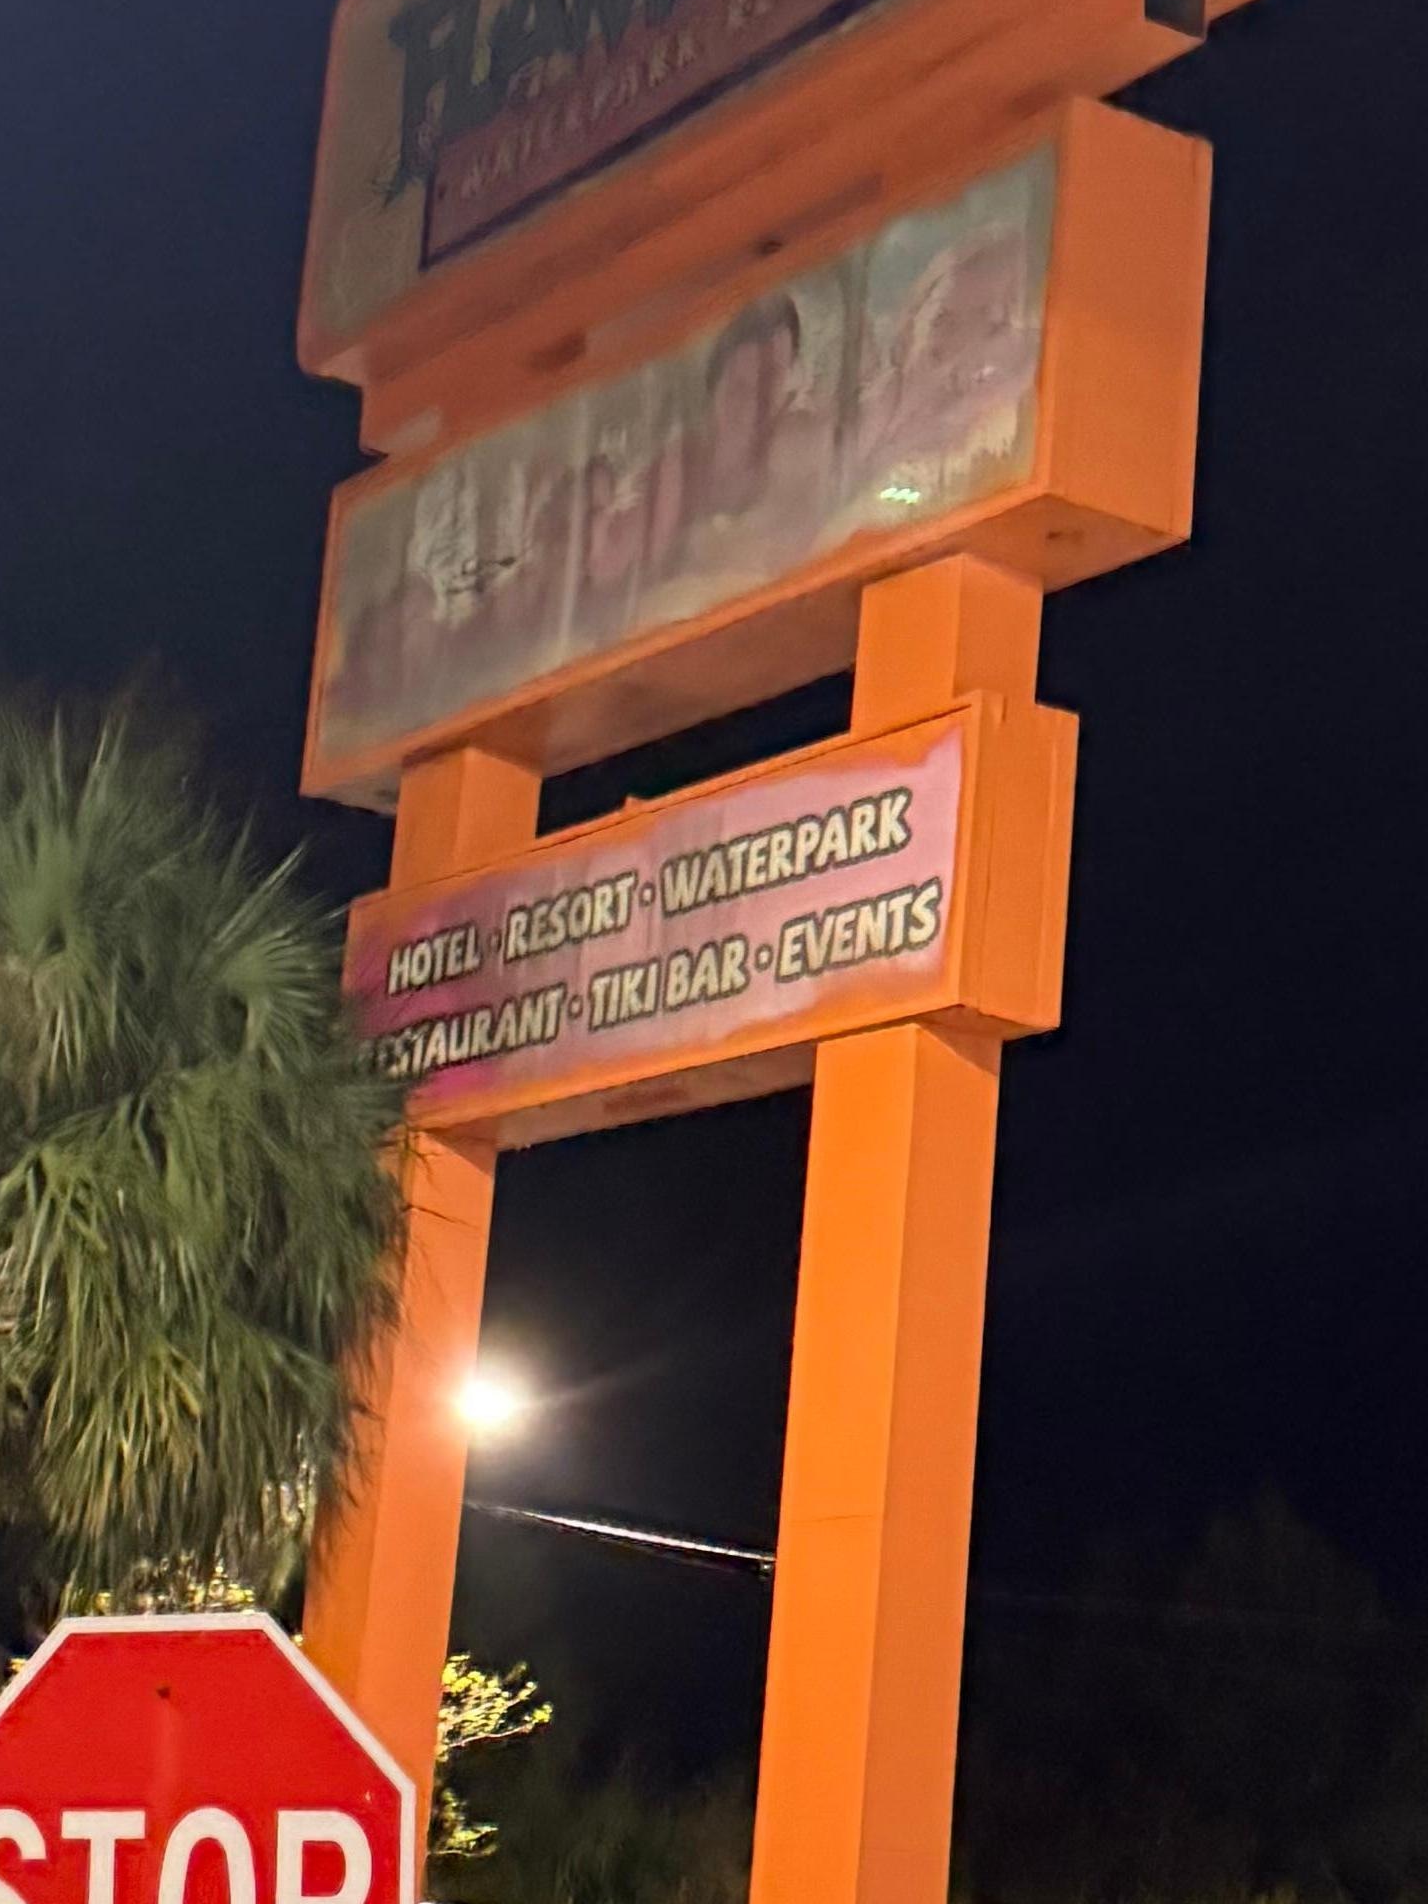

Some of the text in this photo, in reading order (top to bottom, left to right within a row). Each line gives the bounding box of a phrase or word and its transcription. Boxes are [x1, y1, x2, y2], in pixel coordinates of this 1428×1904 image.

[386, 787, 913, 996] HOTEL RESORT WATERPARK
[589, 959, 661, 1030] TIKI
[664, 934, 750, 1010] BAR
[775, 878, 942, 982] EVENTS
